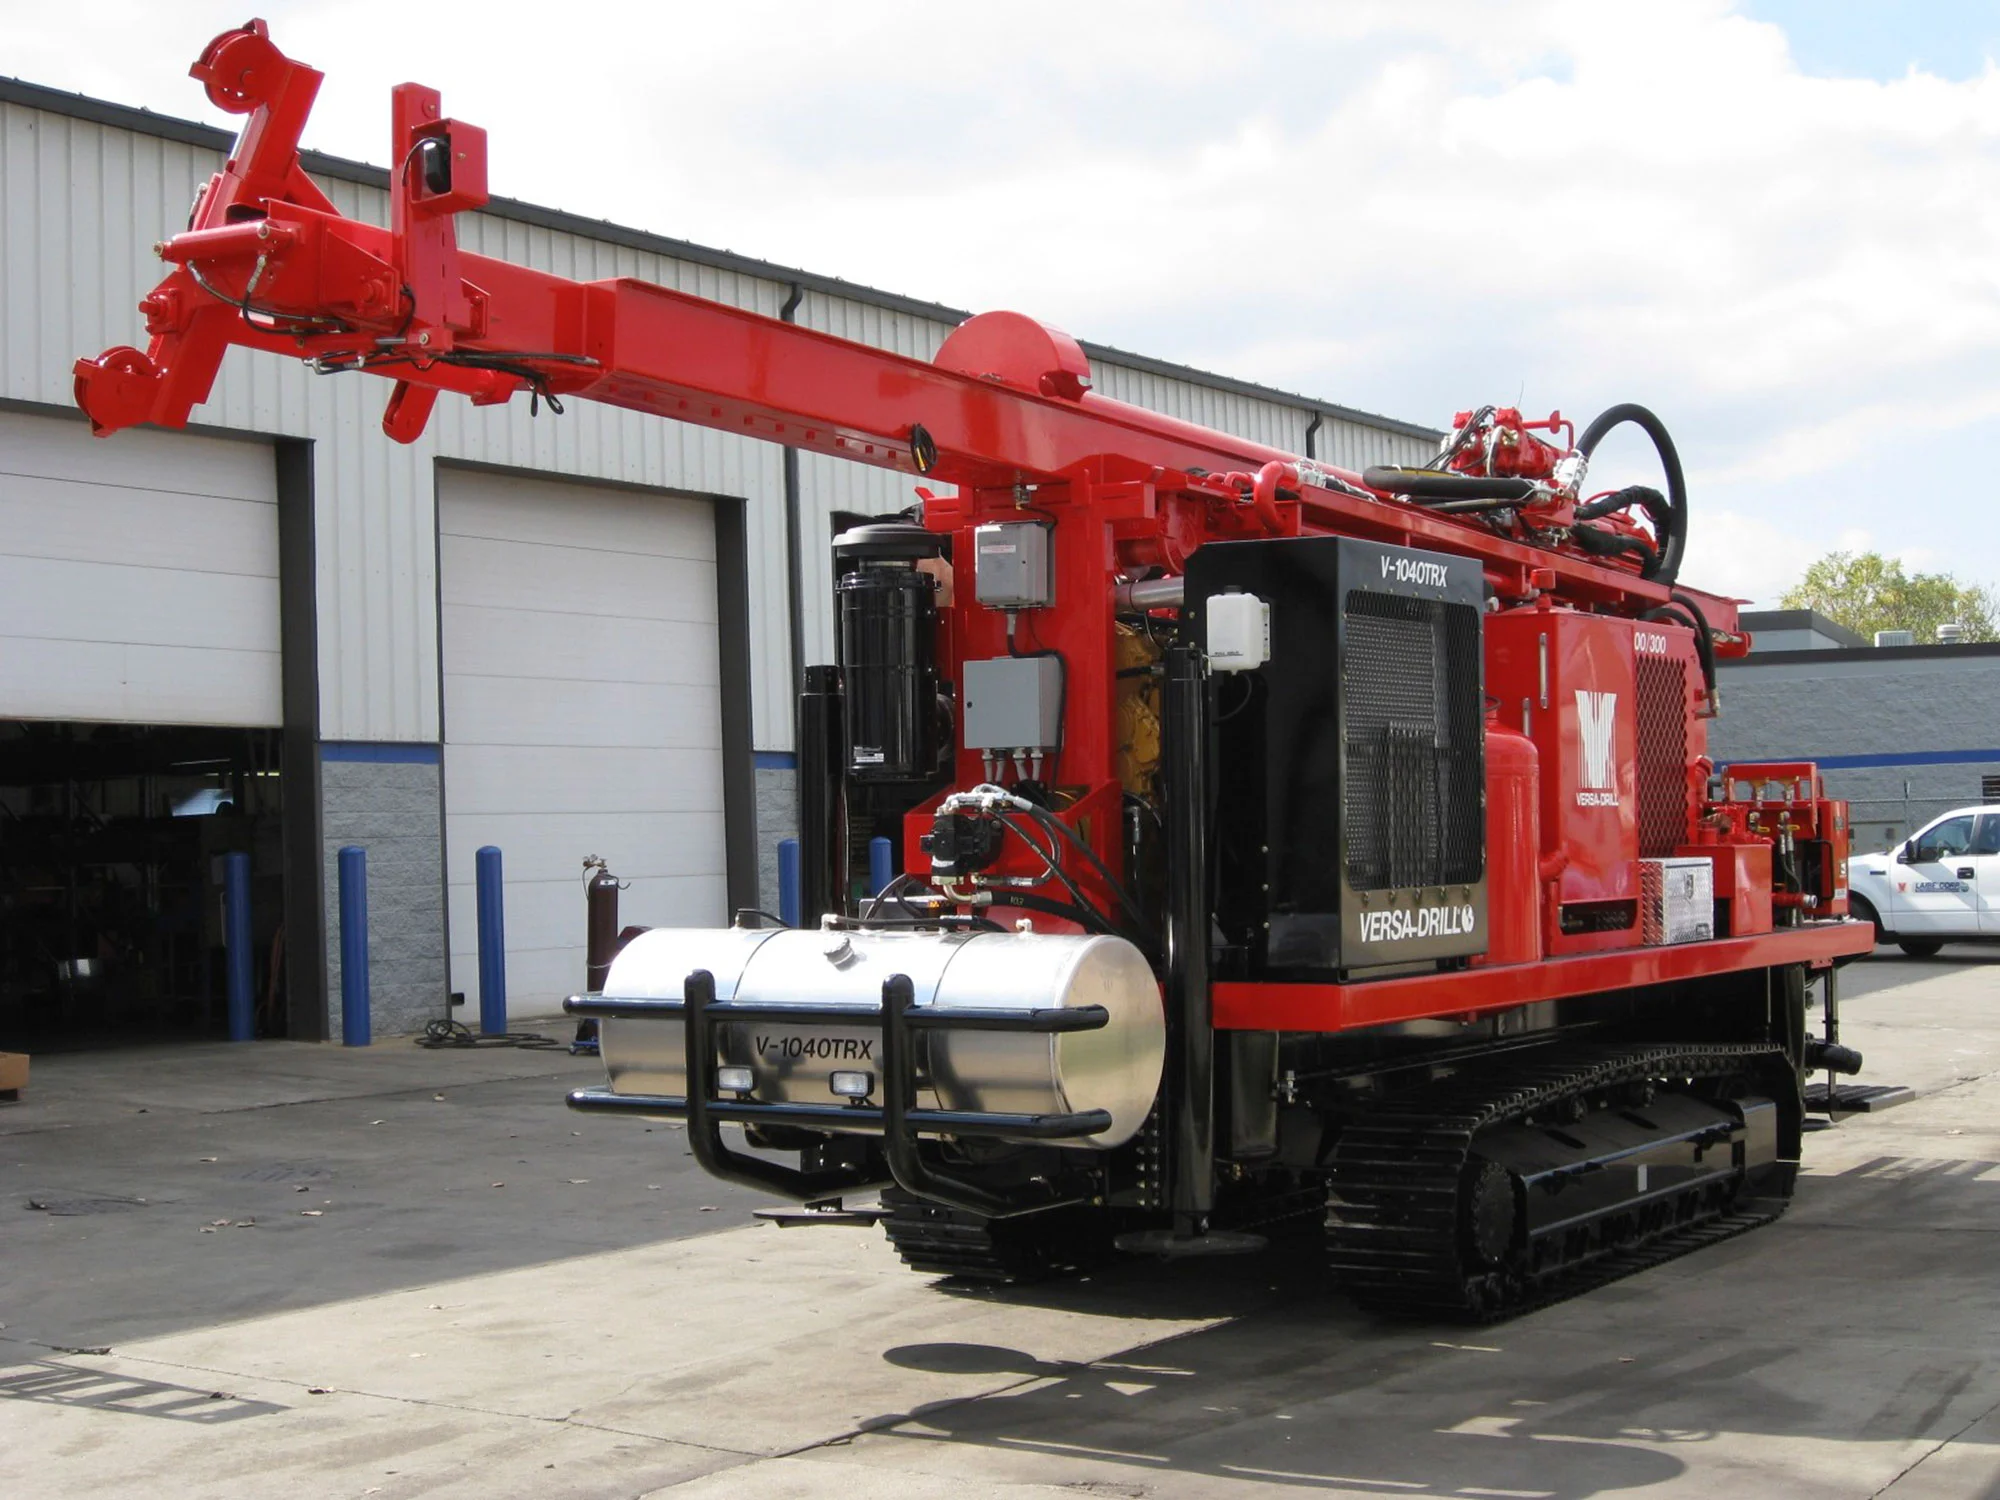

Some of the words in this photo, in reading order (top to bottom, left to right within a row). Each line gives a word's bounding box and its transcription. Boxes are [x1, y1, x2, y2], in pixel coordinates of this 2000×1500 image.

[1381, 555, 1448, 587] V-1040TRX
[1576, 792, 1619, 806] VERSA-DRILL
[1360, 906, 1462, 942] VERSA-DRILL
[756, 1036, 873, 1060] V-1040TRX
